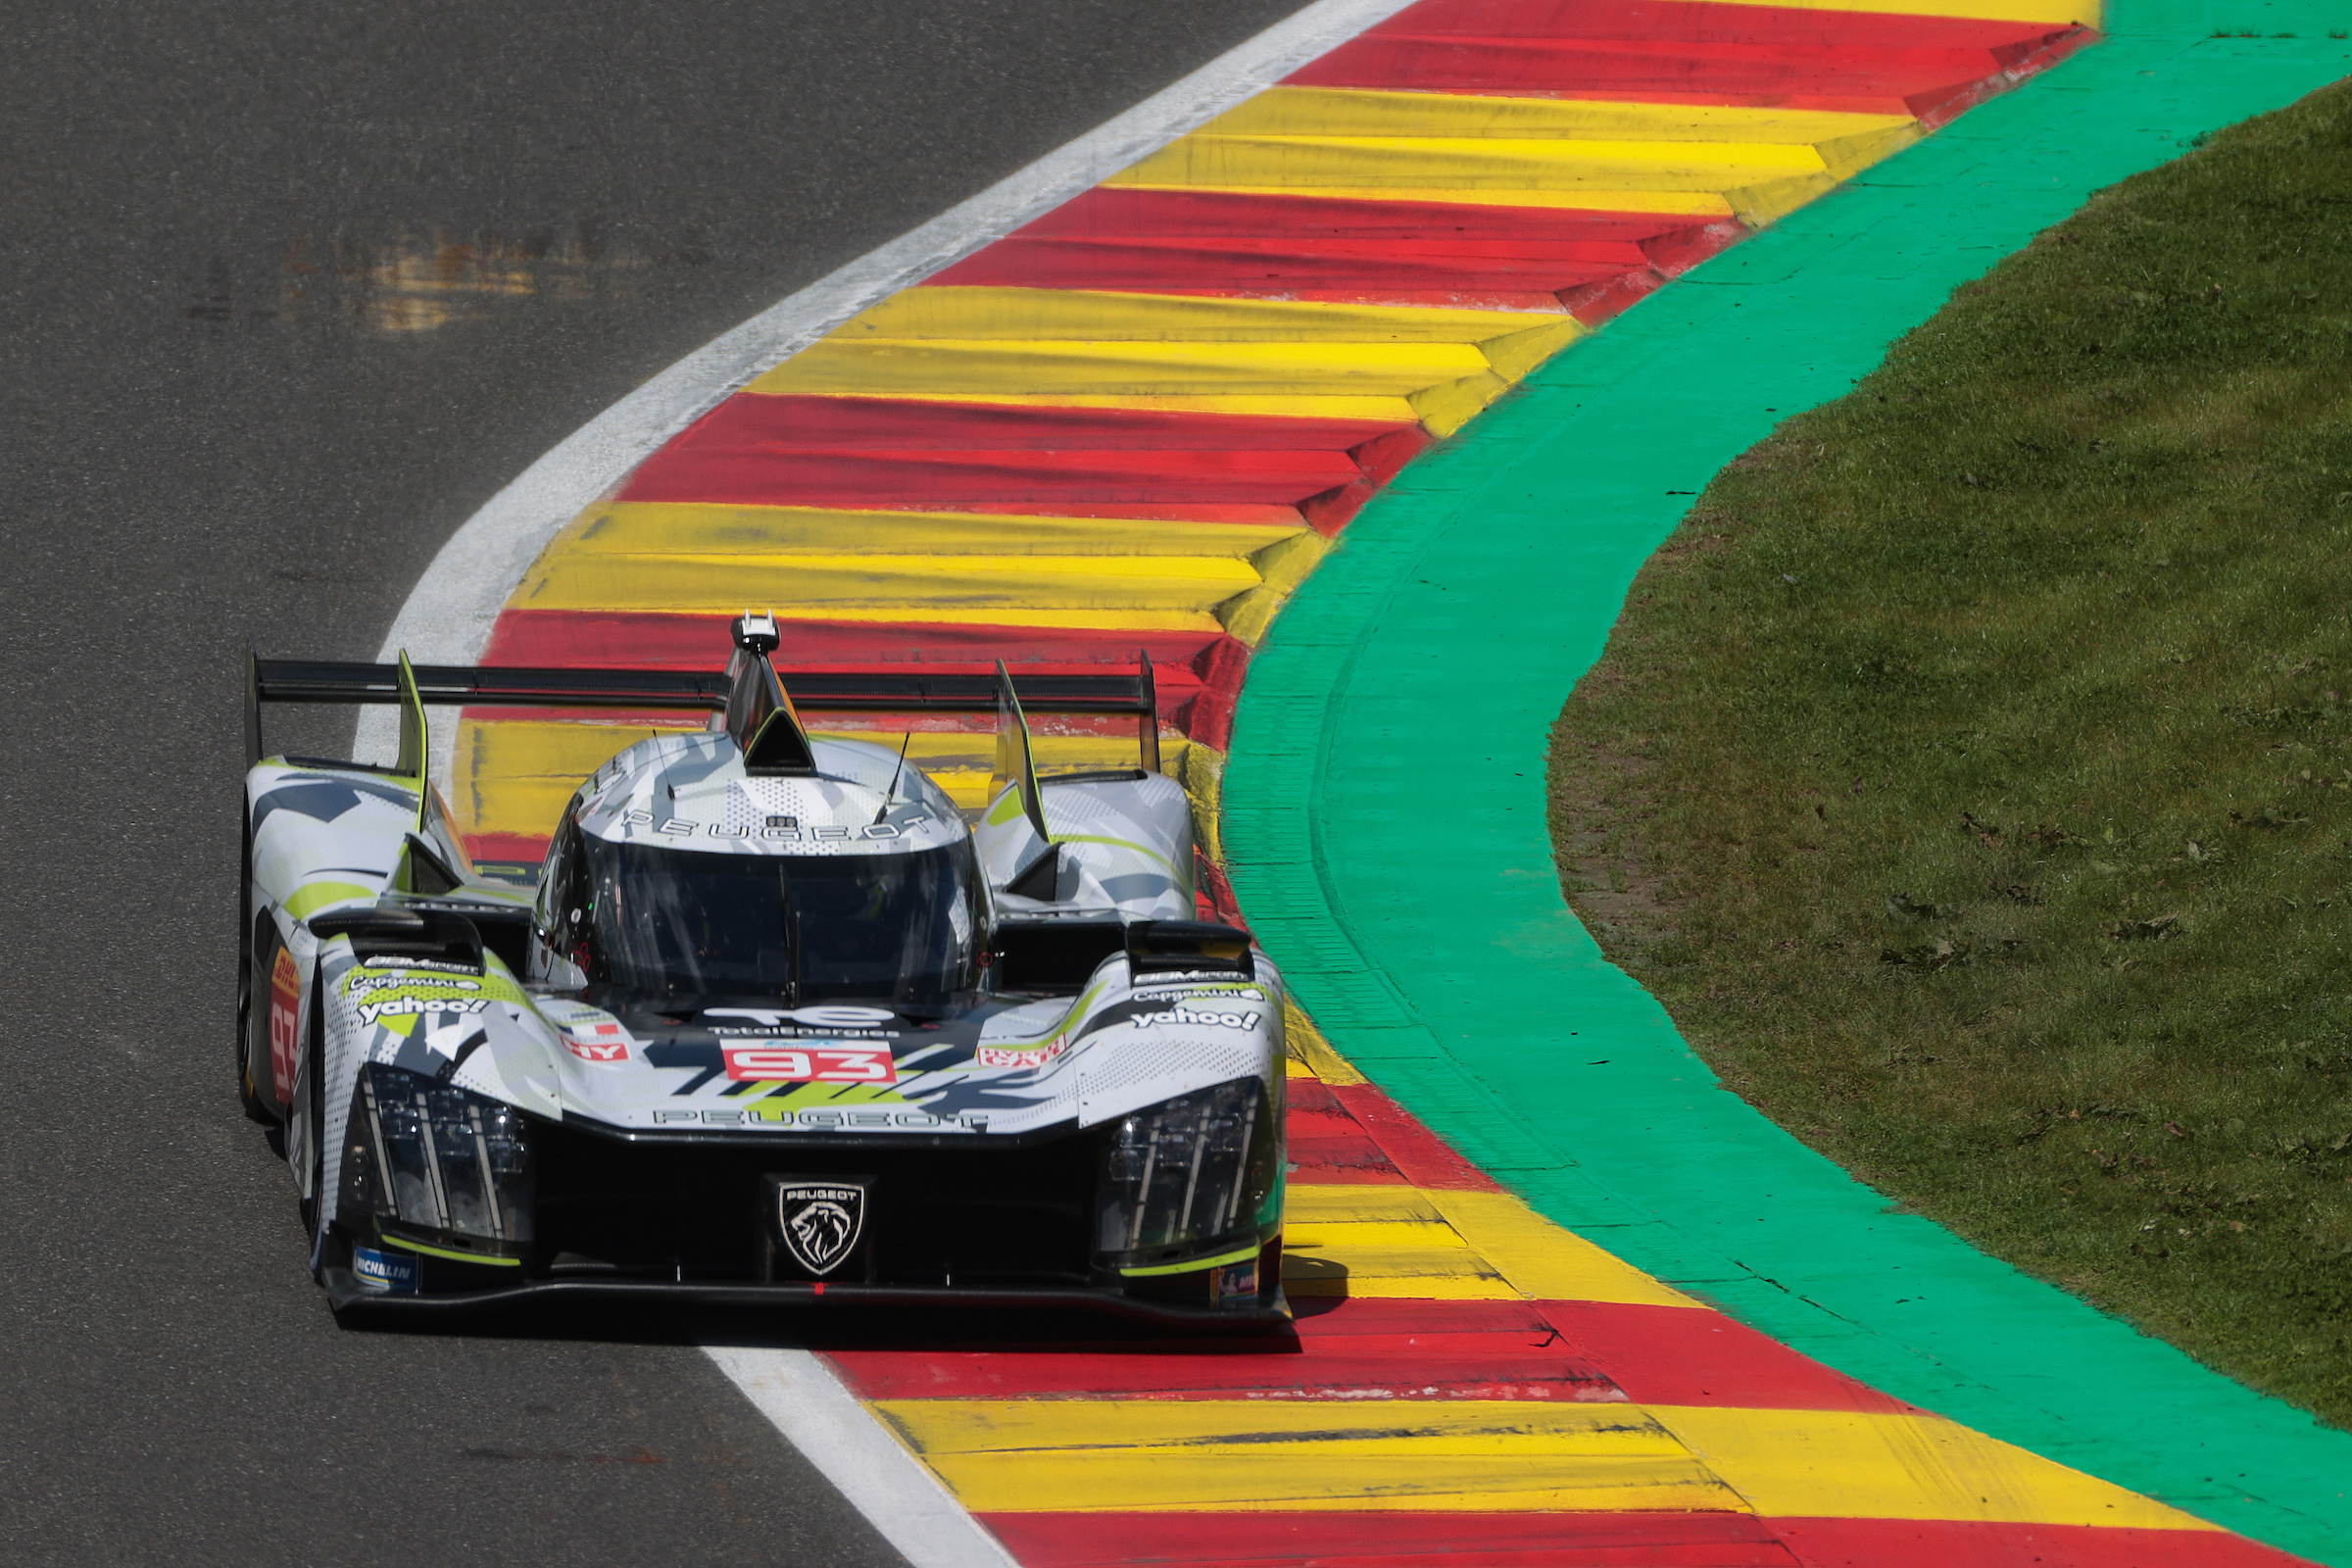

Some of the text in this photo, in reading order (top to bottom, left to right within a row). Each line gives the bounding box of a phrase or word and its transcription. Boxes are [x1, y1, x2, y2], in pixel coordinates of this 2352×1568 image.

[620, 808, 930, 842] PEUGEOT
[349, 975, 458, 992] Capgemini
[1132, 988, 1241, 1003] Capgemini
[358, 996, 489, 1028] yahoo!
[1130, 1006, 1261, 1032] yahoo!
[707, 1025, 901, 1038] TotalEnergies
[732, 1051, 887, 1079] 93
[652, 1109, 989, 1129] PEUGEOT
[786, 1189, 858, 1200] PEUGEOT
[357, 1255, 411, 1280] MICHELIN
